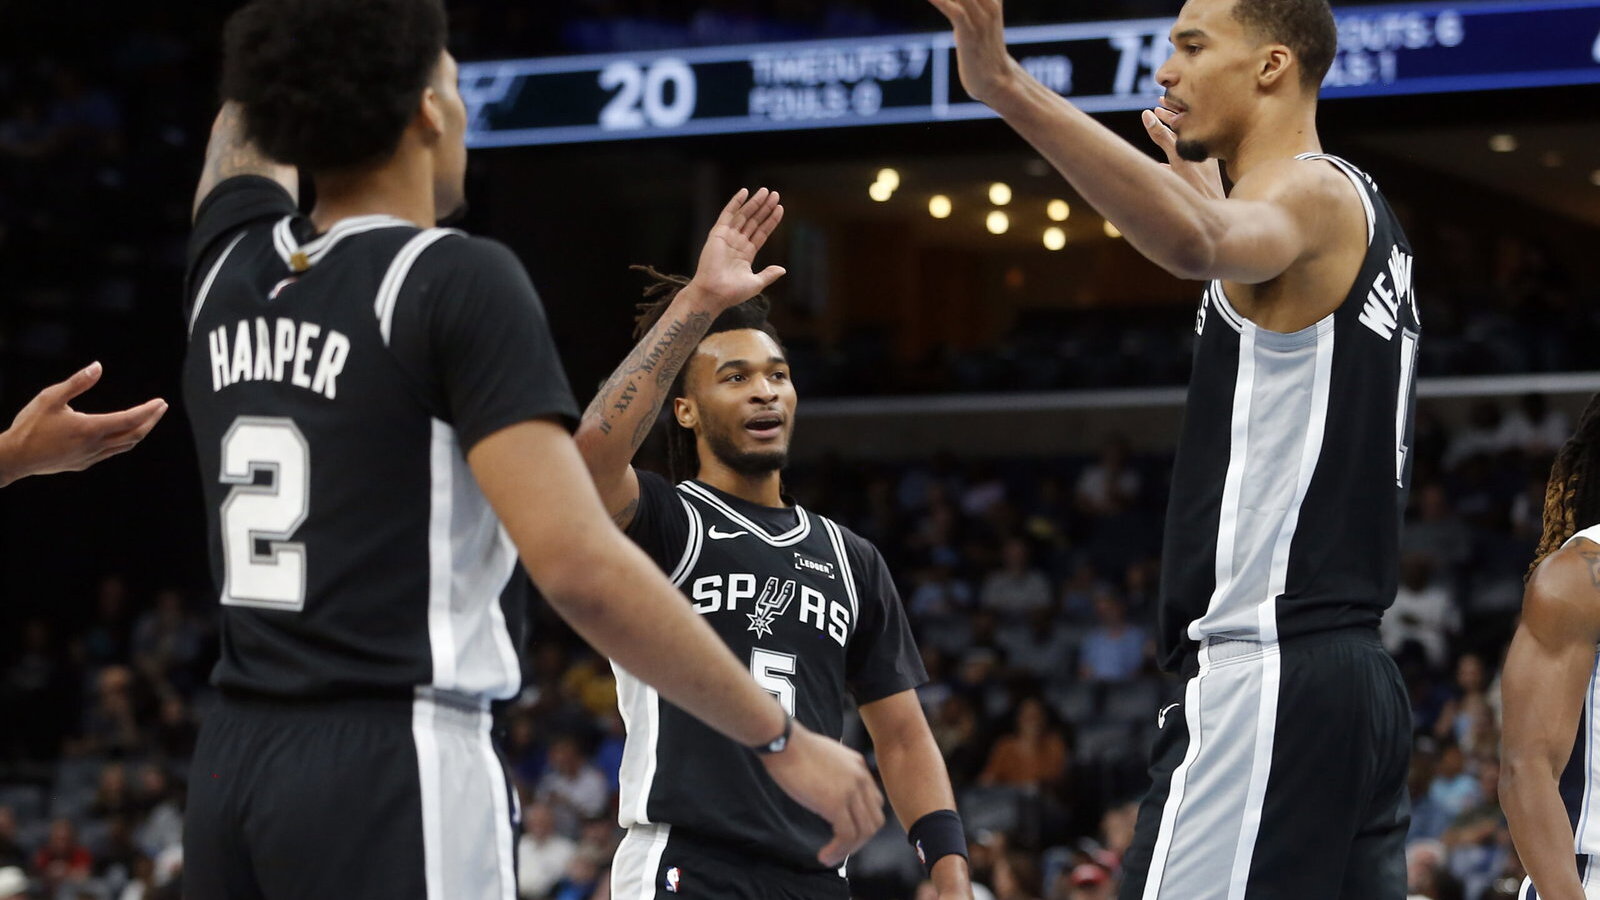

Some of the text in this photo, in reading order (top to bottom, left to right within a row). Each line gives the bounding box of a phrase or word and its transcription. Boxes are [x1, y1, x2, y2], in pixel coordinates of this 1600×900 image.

[598, 57, 697, 130] 20
[209, 316, 351, 400] HARPER
[219, 415, 311, 612] 2
[799, 557, 830, 575] LEDGER
[751, 647, 797, 720] 5
